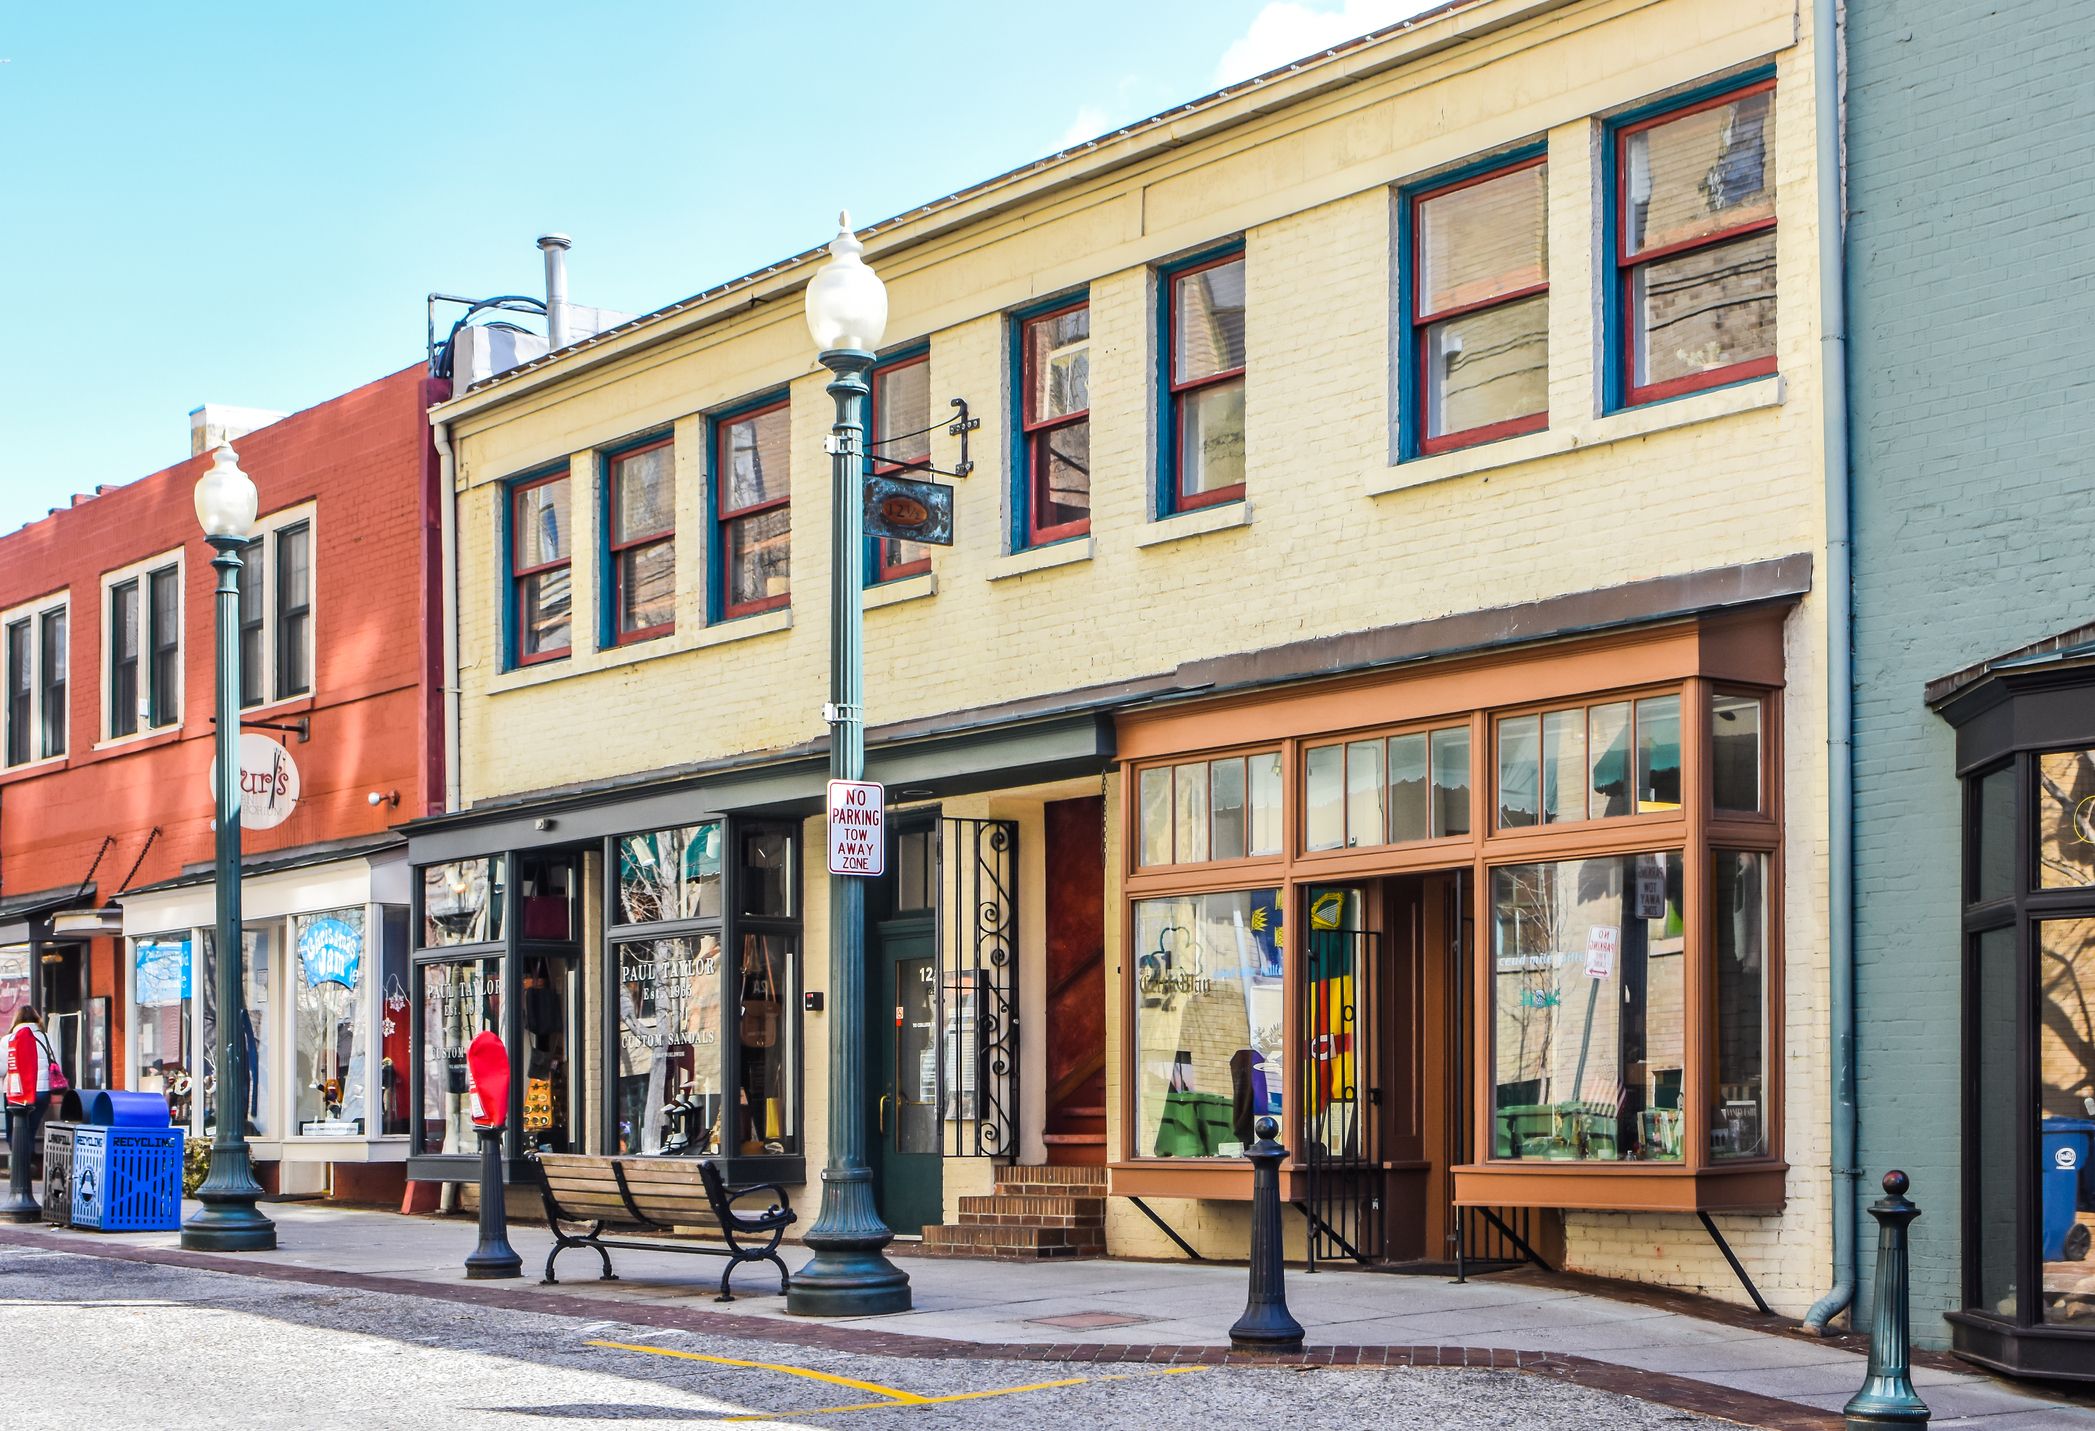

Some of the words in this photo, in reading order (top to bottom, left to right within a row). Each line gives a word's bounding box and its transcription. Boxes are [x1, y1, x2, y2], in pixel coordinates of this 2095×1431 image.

[846, 789, 866, 806] NO
[832, 808, 879, 826] PARKING
[844, 828, 868, 841] TOW
[837, 842, 874, 856] AWAY
[843, 857, 869, 870] ZONE
[318, 947, 346, 977] Jam
[622, 963, 656, 982] PAUL
[661, 957, 715, 979] TAYLOR
[427, 983, 455, 999] PAUL
[643, 986, 665, 1000] Est.
[622, 1033, 662, 1049] CUSTOM
[668, 1030, 714, 1045] SANDALS
[113, 1136, 175, 1148] RECYCLING
